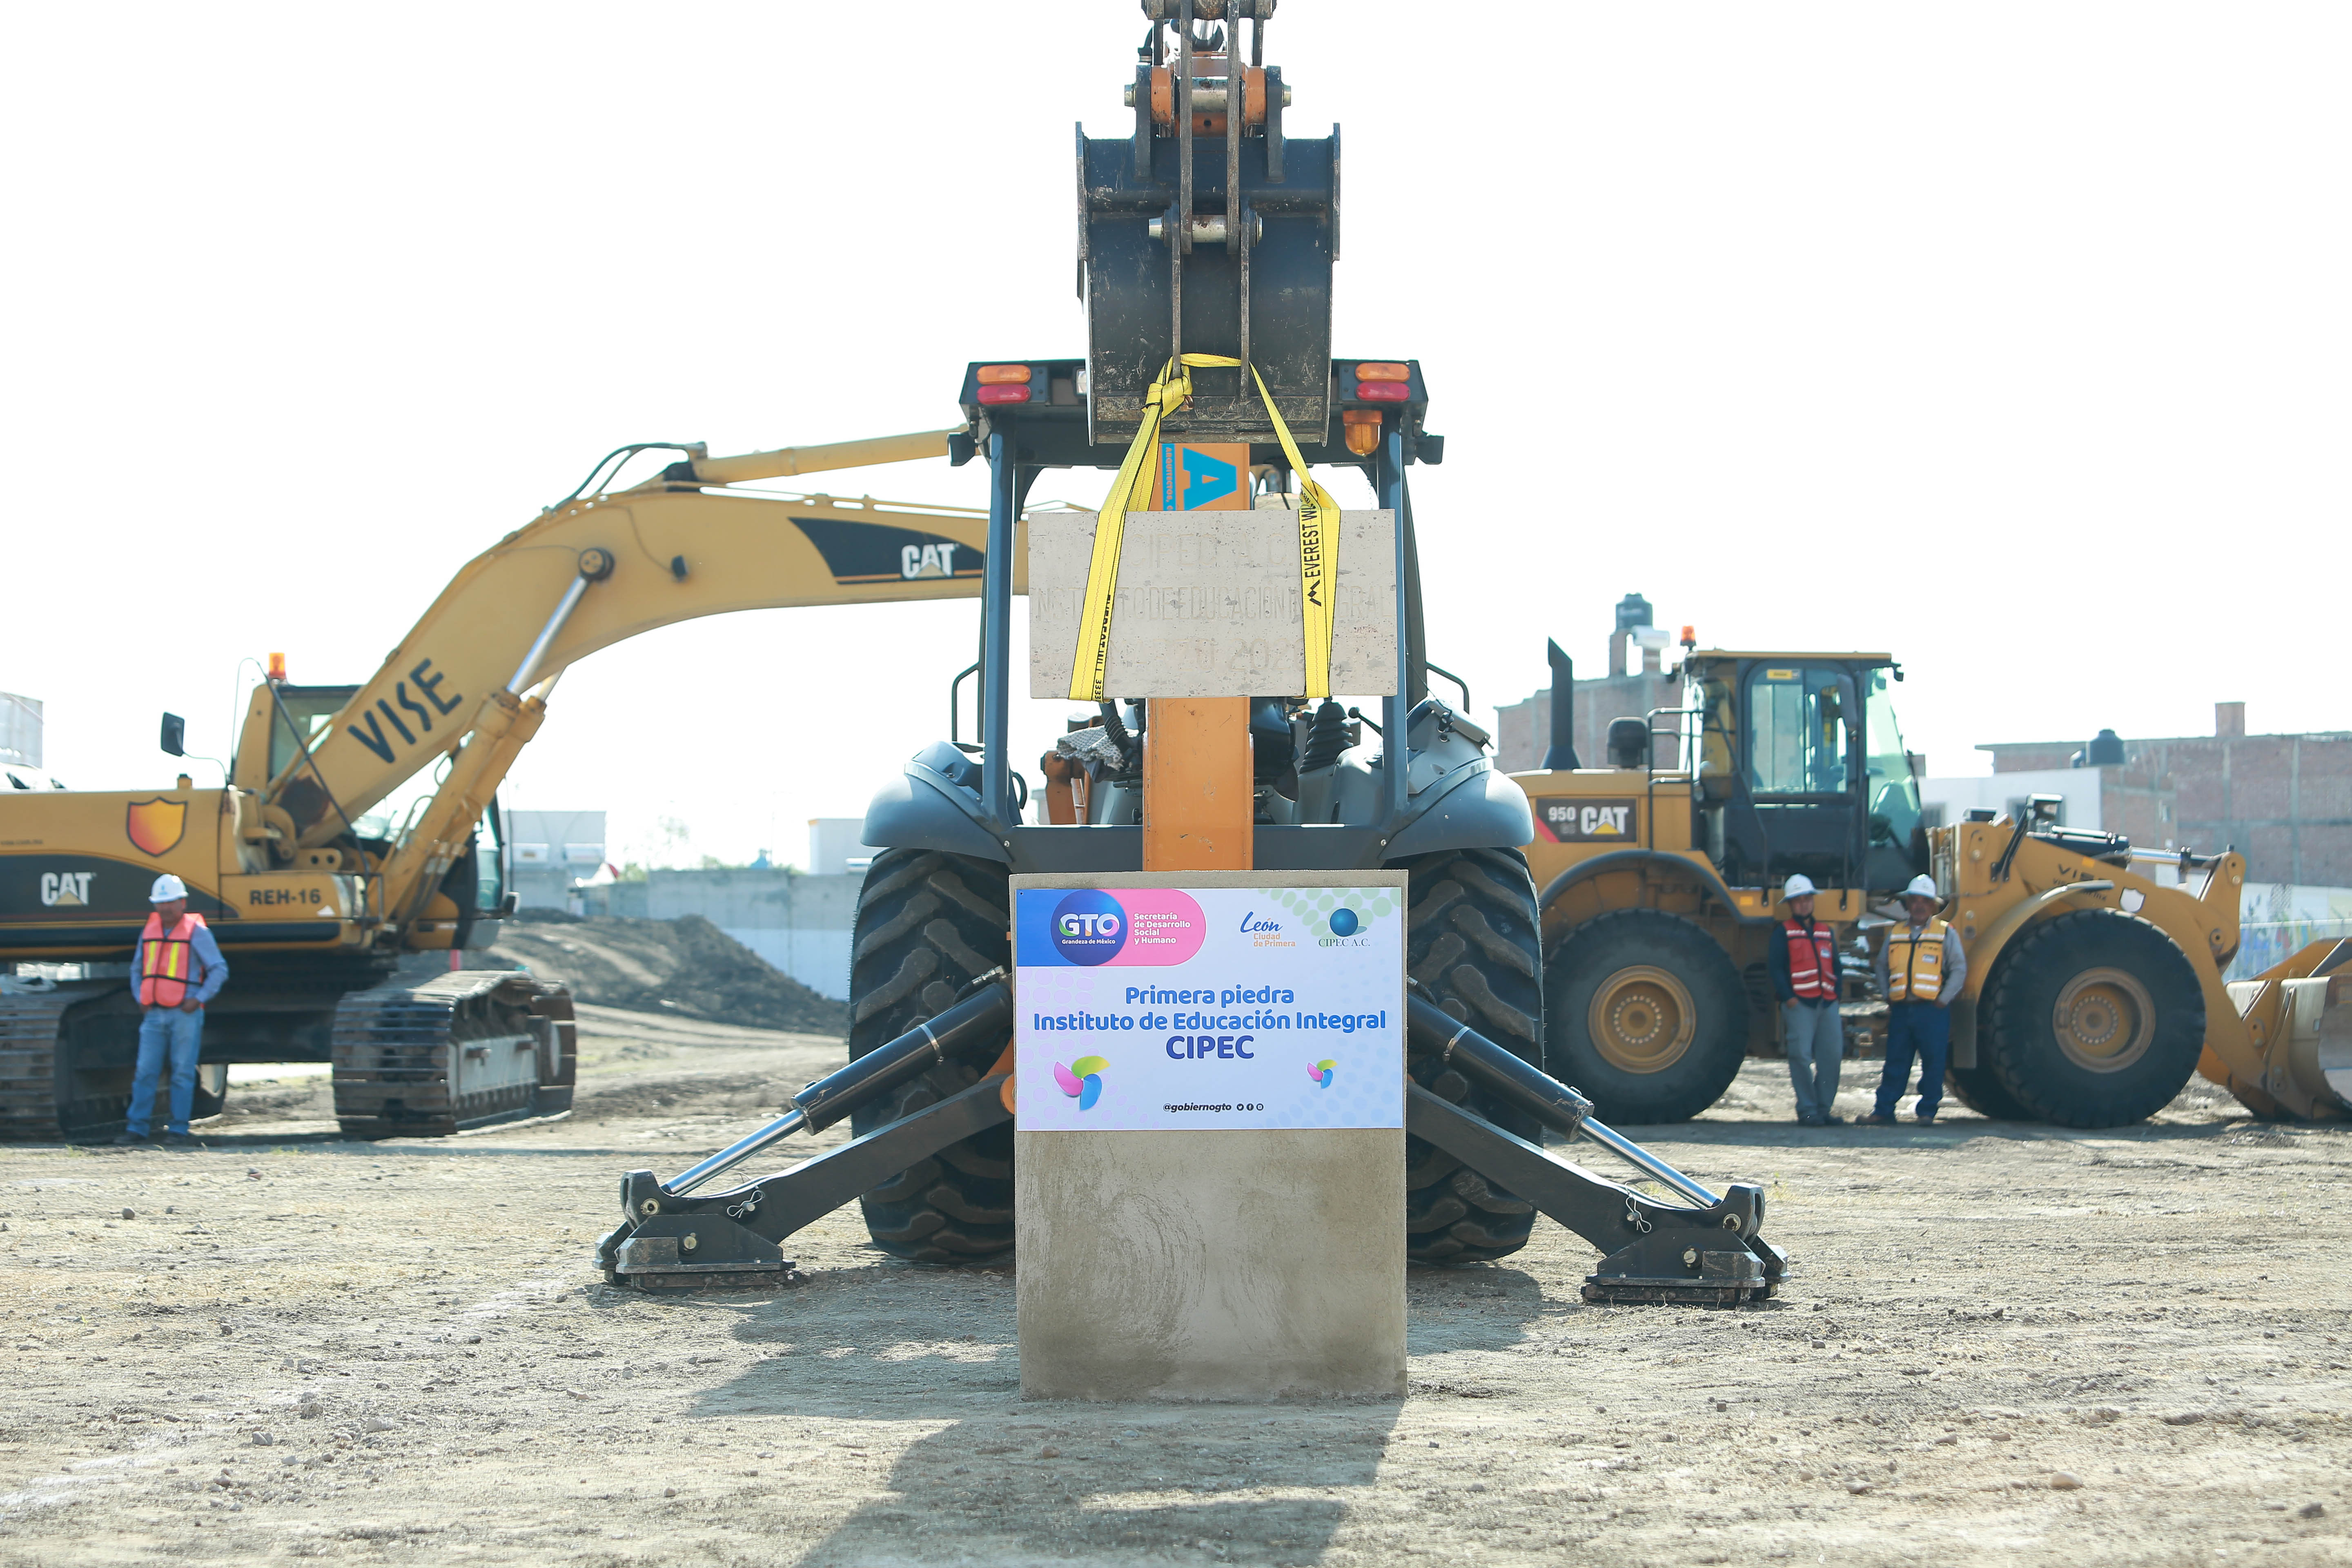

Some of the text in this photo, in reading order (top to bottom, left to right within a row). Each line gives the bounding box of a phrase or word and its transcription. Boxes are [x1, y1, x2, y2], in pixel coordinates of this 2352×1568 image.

[901, 543, 956, 579] CAT
[1128, 533, 1217, 568] CIPEC
[1302, 524, 1321, 578] EVEREST
[1149, 586, 1173, 620] DE
[347, 658, 463, 764] VISE
[1548, 806, 1629, 835] 950 CAT
[41, 872, 91, 906] CAT
[249, 889, 321, 905] REH-16
[1059, 913, 1120, 937] GTO
[1134, 912, 1178, 920] Secretaría
[1240, 911, 1283, 933] León
[1319, 938, 1370, 947] CIPEC A.C.
[1126, 984, 1294, 1008] Primera piedra
[1034, 1009, 1385, 1033] Instituto de Educación Integral
[1166, 1035, 1254, 1059] CIPEC
[1163, 1102, 1232, 1113] @gobiernogto
